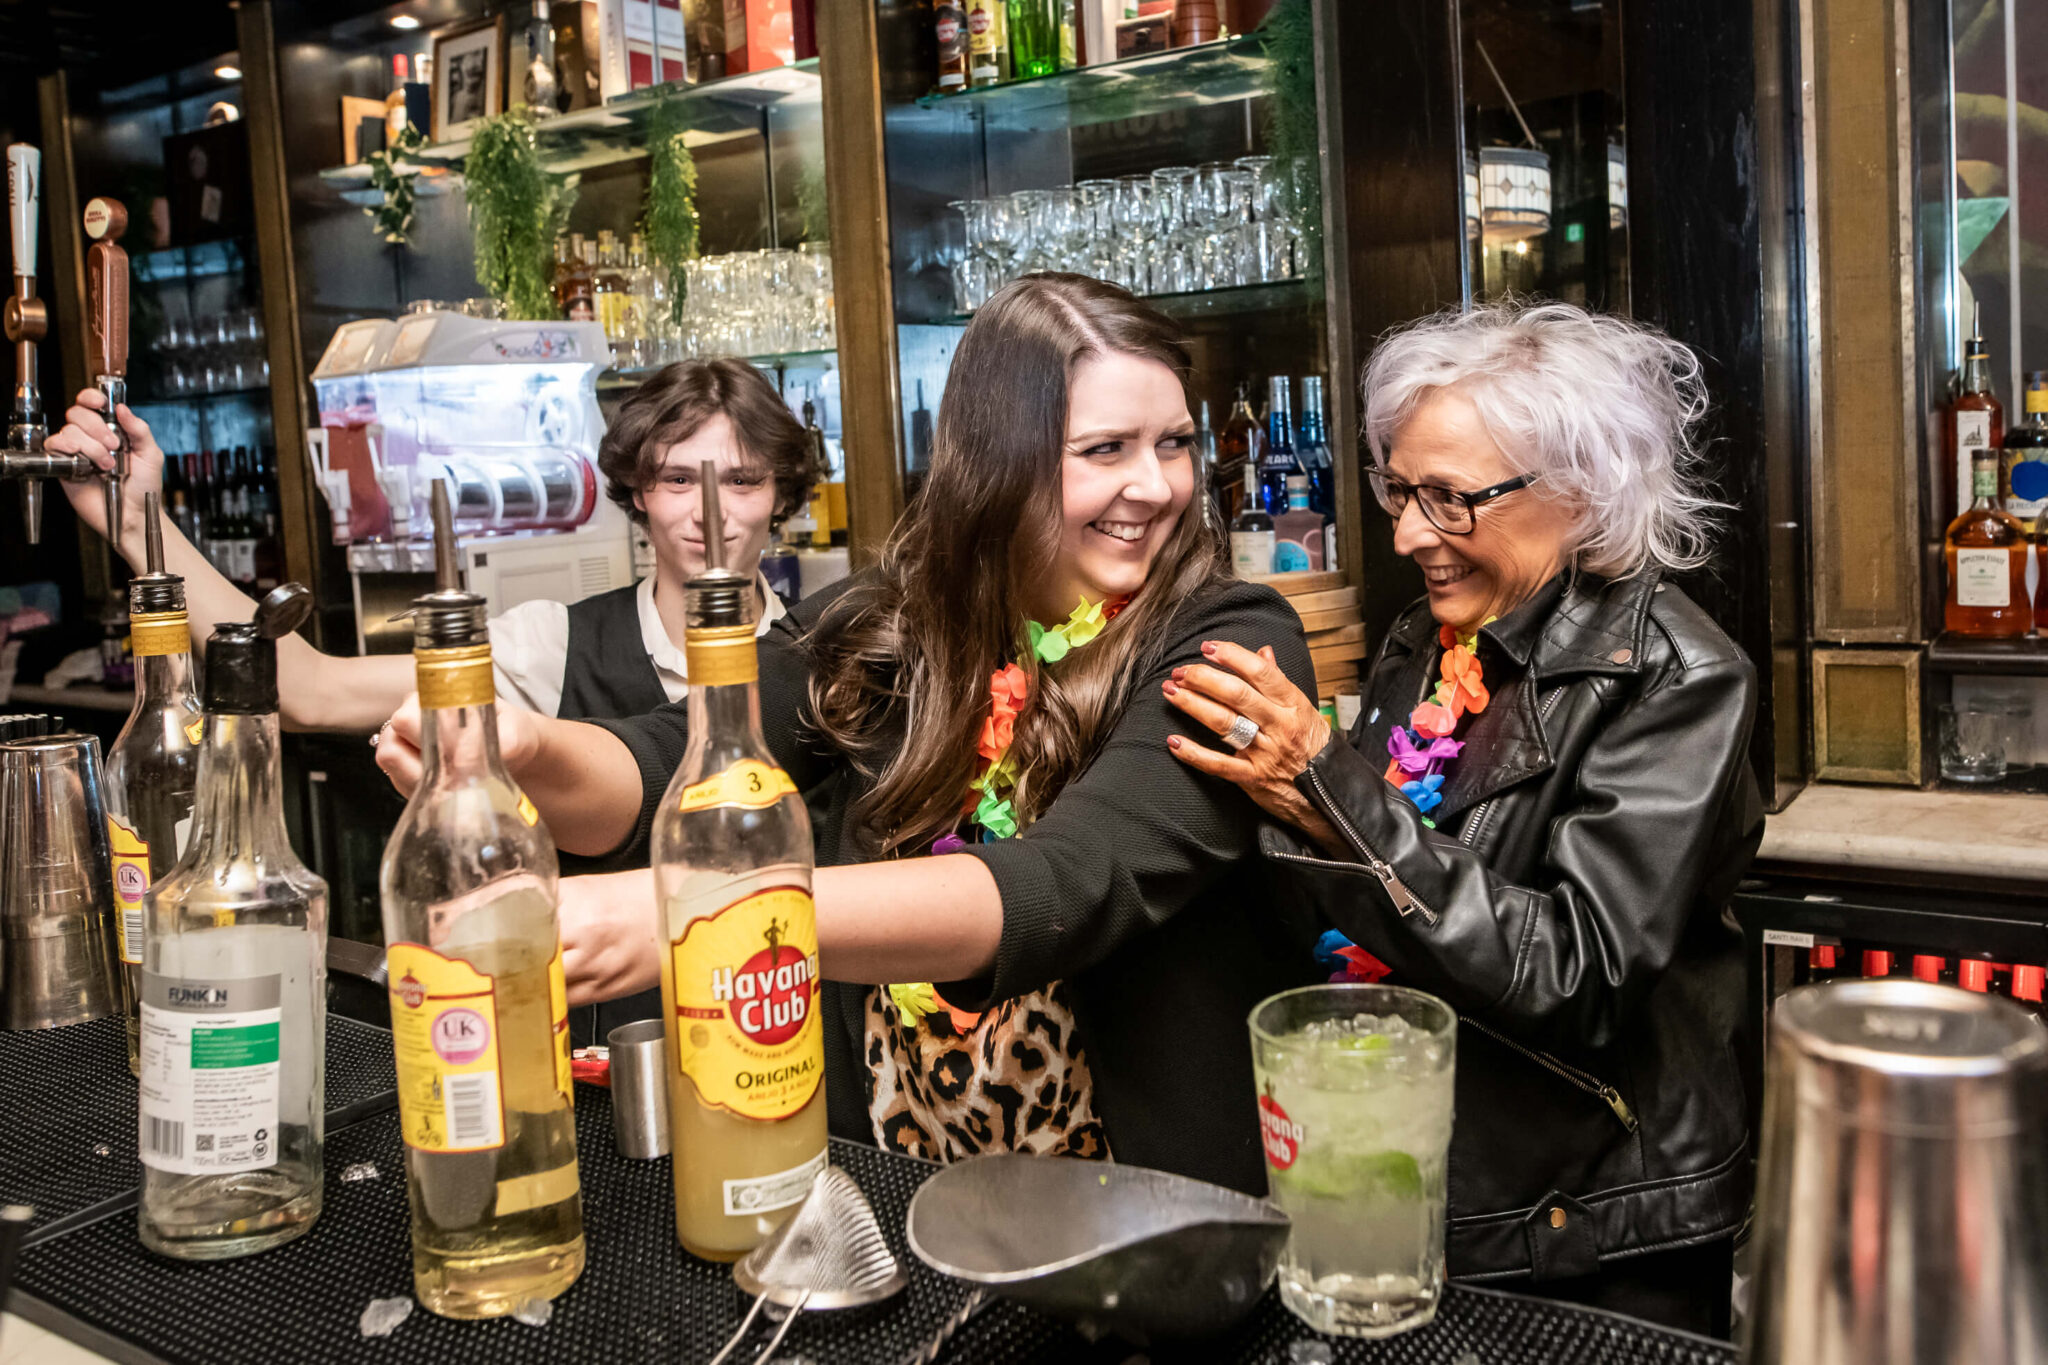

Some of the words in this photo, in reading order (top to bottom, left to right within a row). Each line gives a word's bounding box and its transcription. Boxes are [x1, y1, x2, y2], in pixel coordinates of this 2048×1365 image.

[746, 771, 762, 793] 3
[120, 871, 138, 884] UK
[711, 952, 817, 1001] Havana
[739, 989, 806, 1034] Club
[443, 1020, 475, 1038] UK
